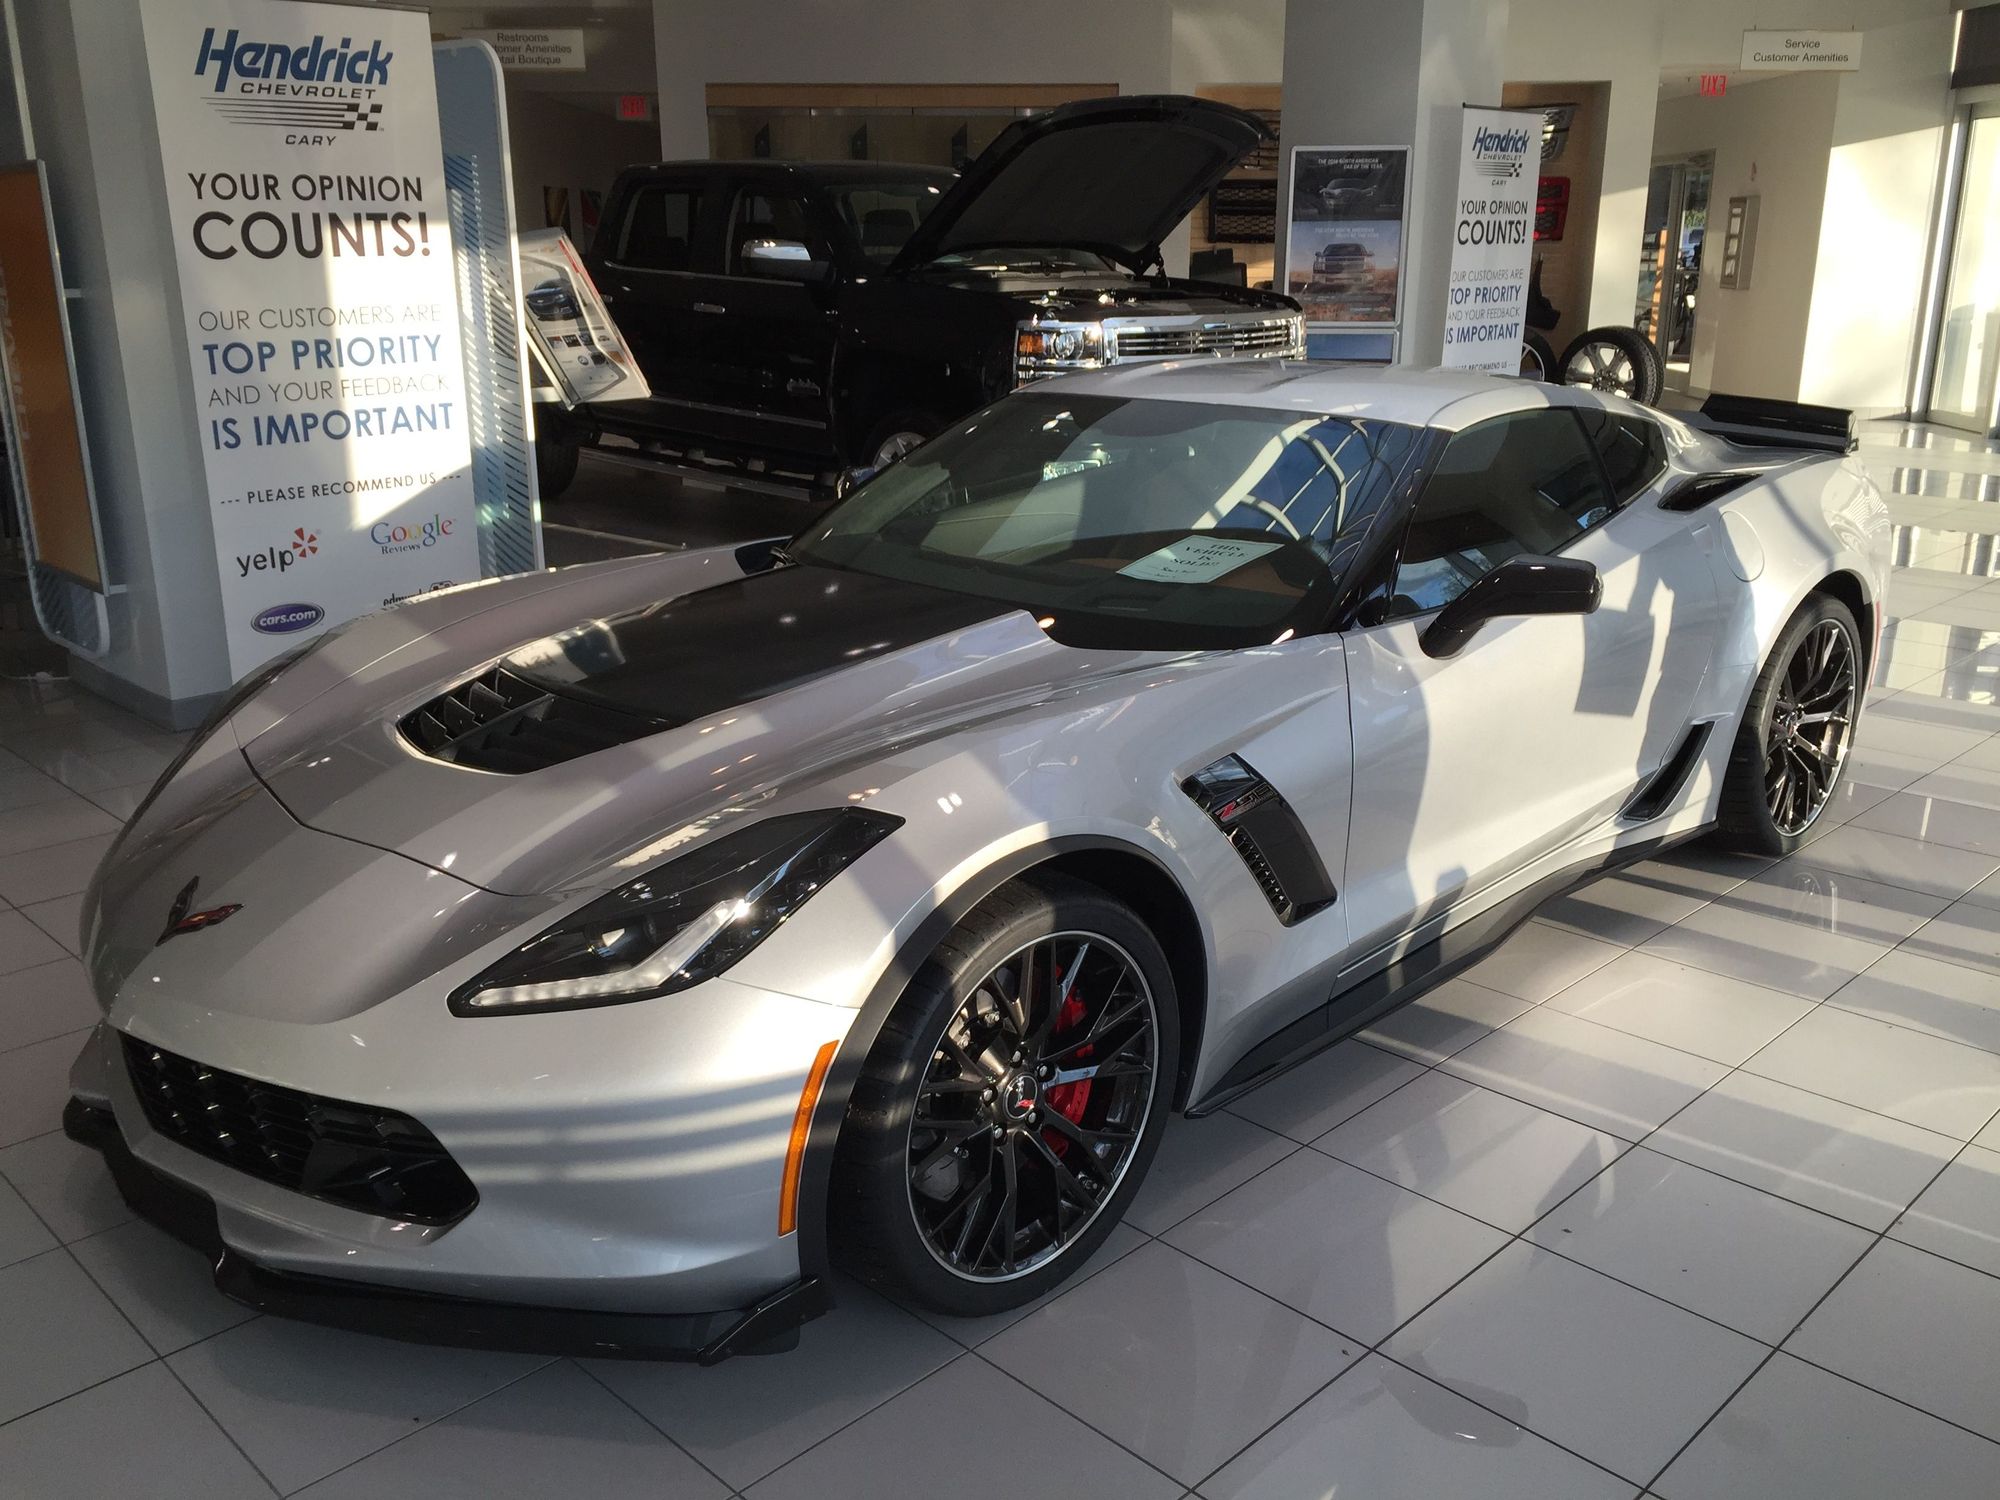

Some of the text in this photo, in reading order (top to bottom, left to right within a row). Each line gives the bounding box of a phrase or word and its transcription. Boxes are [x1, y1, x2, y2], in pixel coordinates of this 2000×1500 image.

[497, 33, 549, 42] Restrooms
[1785, 39, 1820, 48] Service
[494, 44, 572, 53] tomer Amenities
[1753, 53, 1848, 62] Customer Amenities
[195, 28, 393, 92] Hendrick
[500, 55, 561, 65] tail Boutique
[240, 82, 376, 100] CHEVROLET
[285, 134, 336, 146] CARY
[1472, 126, 1530, 159] Hendrick
[1483, 153, 1522, 161] CHEVROLET
[188, 173, 423, 201] YOUR OPINION
[1461, 200, 1528, 214] YOUR OPINION
[193, 211, 431, 260] COUNTS!
[1457, 219, 1527, 245] COUNTS!
[1452, 268, 1524, 282] OUR CUSTOMERS ARE
[1451, 285, 1521, 304] TOP PRIORITY
[199, 303, 441, 331] OUR CUSTOMERS ARE
[1448, 306, 1520, 321] AND YOUR FEEDBACK
[1445, 322, 1519, 344] IS IMPORTANT
[203, 334, 441, 375] TOP PRIORITY
[208, 374, 449, 408] AND YOUR FEEDBACK
[212, 402, 453, 450] IS IMPORTANT
[247, 486, 305, 504] PLEASE
[312, 475, 414, 498] RECOMMEND
[421, 472, 436, 485] US
[371, 514, 454, 547] Google
[381, 543, 421, 555] Reviews
[1185, 546, 1247, 557] VEHICLE
[236, 547, 294, 577] yelp
[259, 608, 316, 627] cars.com
